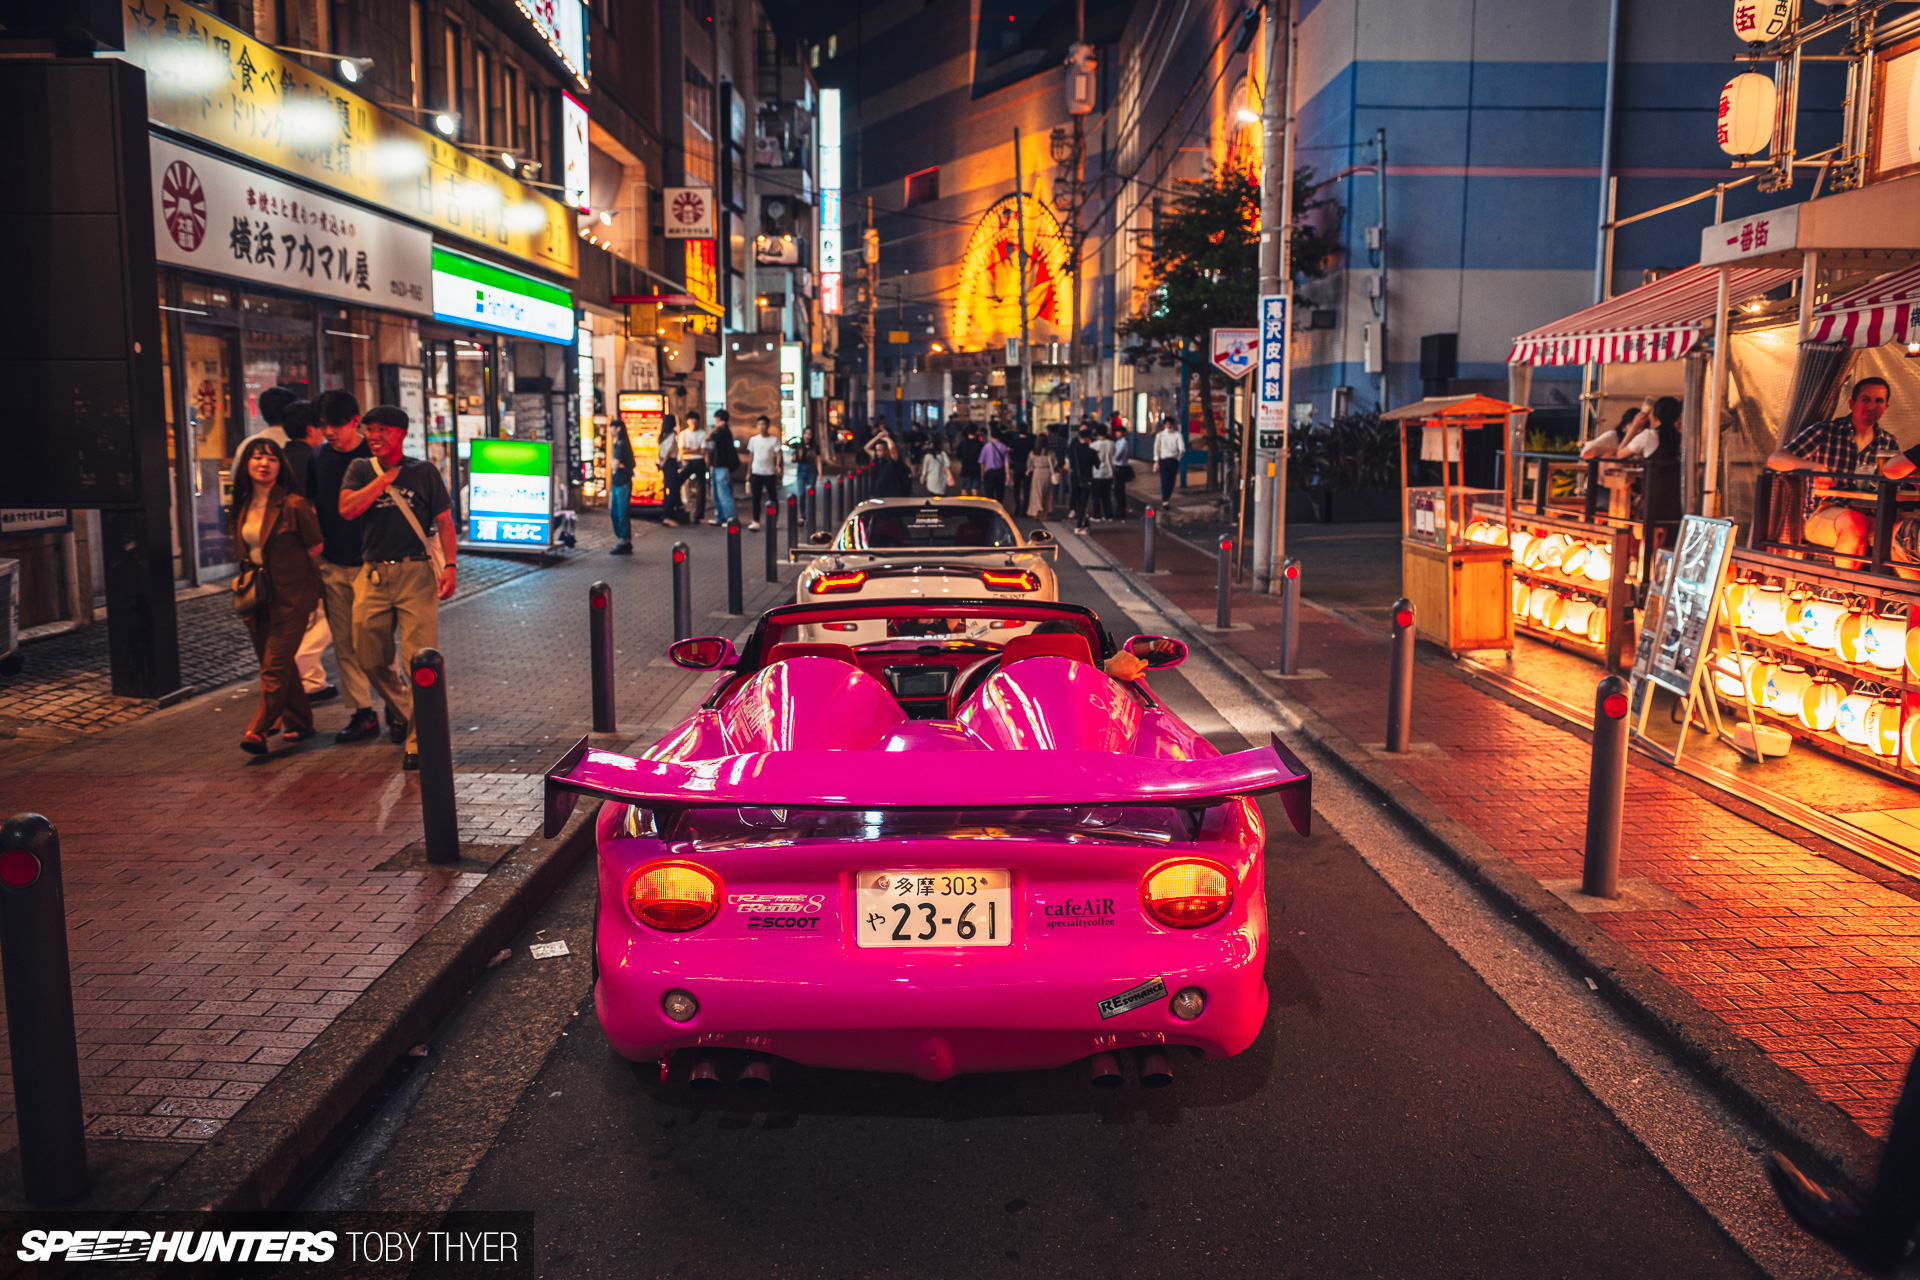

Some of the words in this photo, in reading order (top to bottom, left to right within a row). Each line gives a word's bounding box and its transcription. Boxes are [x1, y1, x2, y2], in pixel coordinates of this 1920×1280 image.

[1726, 219, 1770, 252] 一番街
[229, 215, 371, 292] 横浜アカマル屋
[1264, 300, 1283, 400] 滝沢皮膚科
[894, 876, 936, 897] 多摩
[940, 876, 978, 896] 303
[866, 912, 886, 931] や
[891, 902, 995, 940] 23-61
[1044, 898, 1116, 916] cafeAiR
[1046, 917, 1115, 929] specialtycoffee
